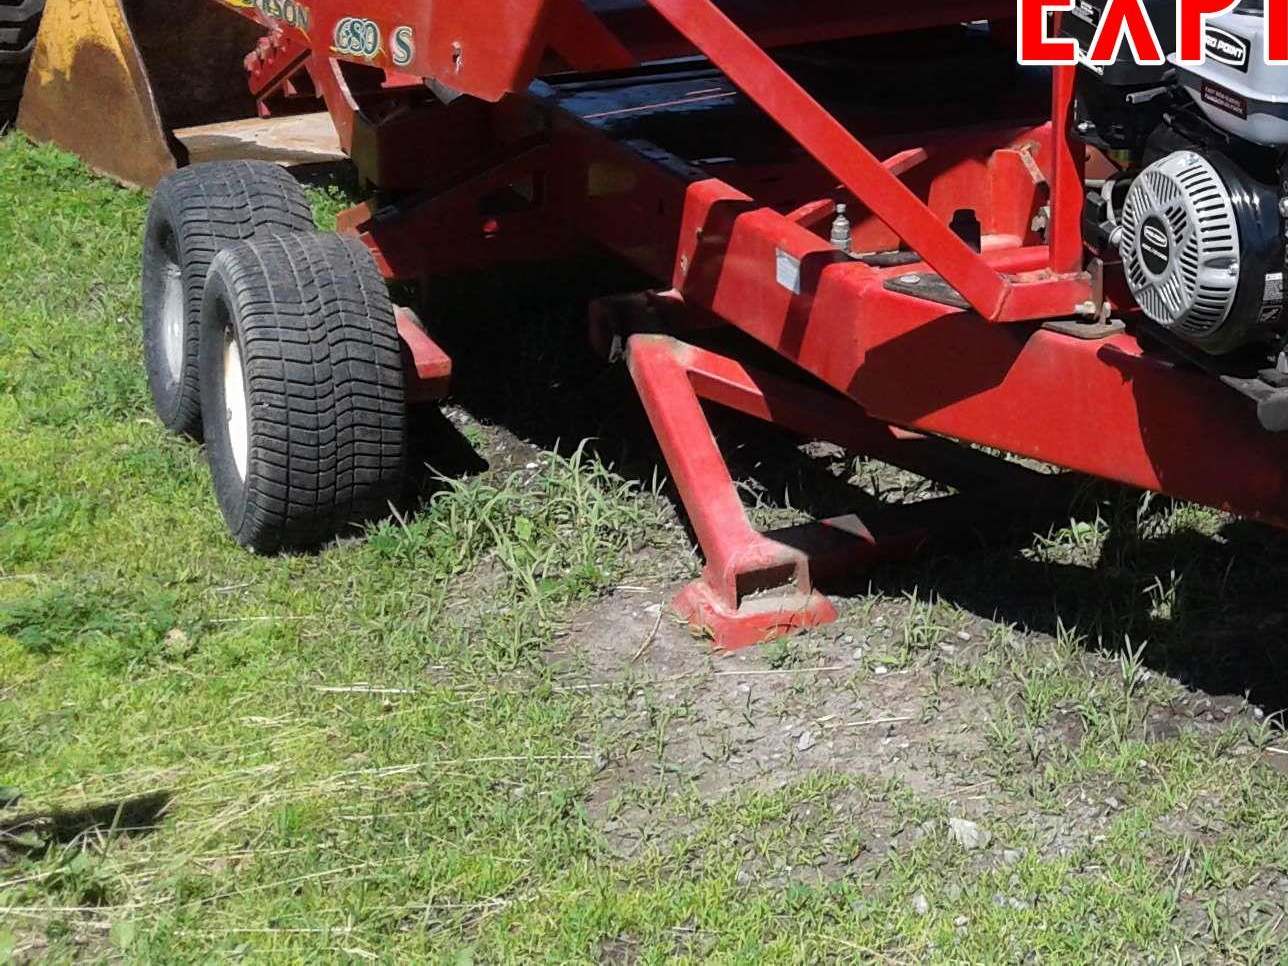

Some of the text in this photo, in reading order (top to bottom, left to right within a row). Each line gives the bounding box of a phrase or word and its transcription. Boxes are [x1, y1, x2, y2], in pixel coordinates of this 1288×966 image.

[334, 17, 413, 65] 680 S
[1217, 40, 1243, 58] POINT
